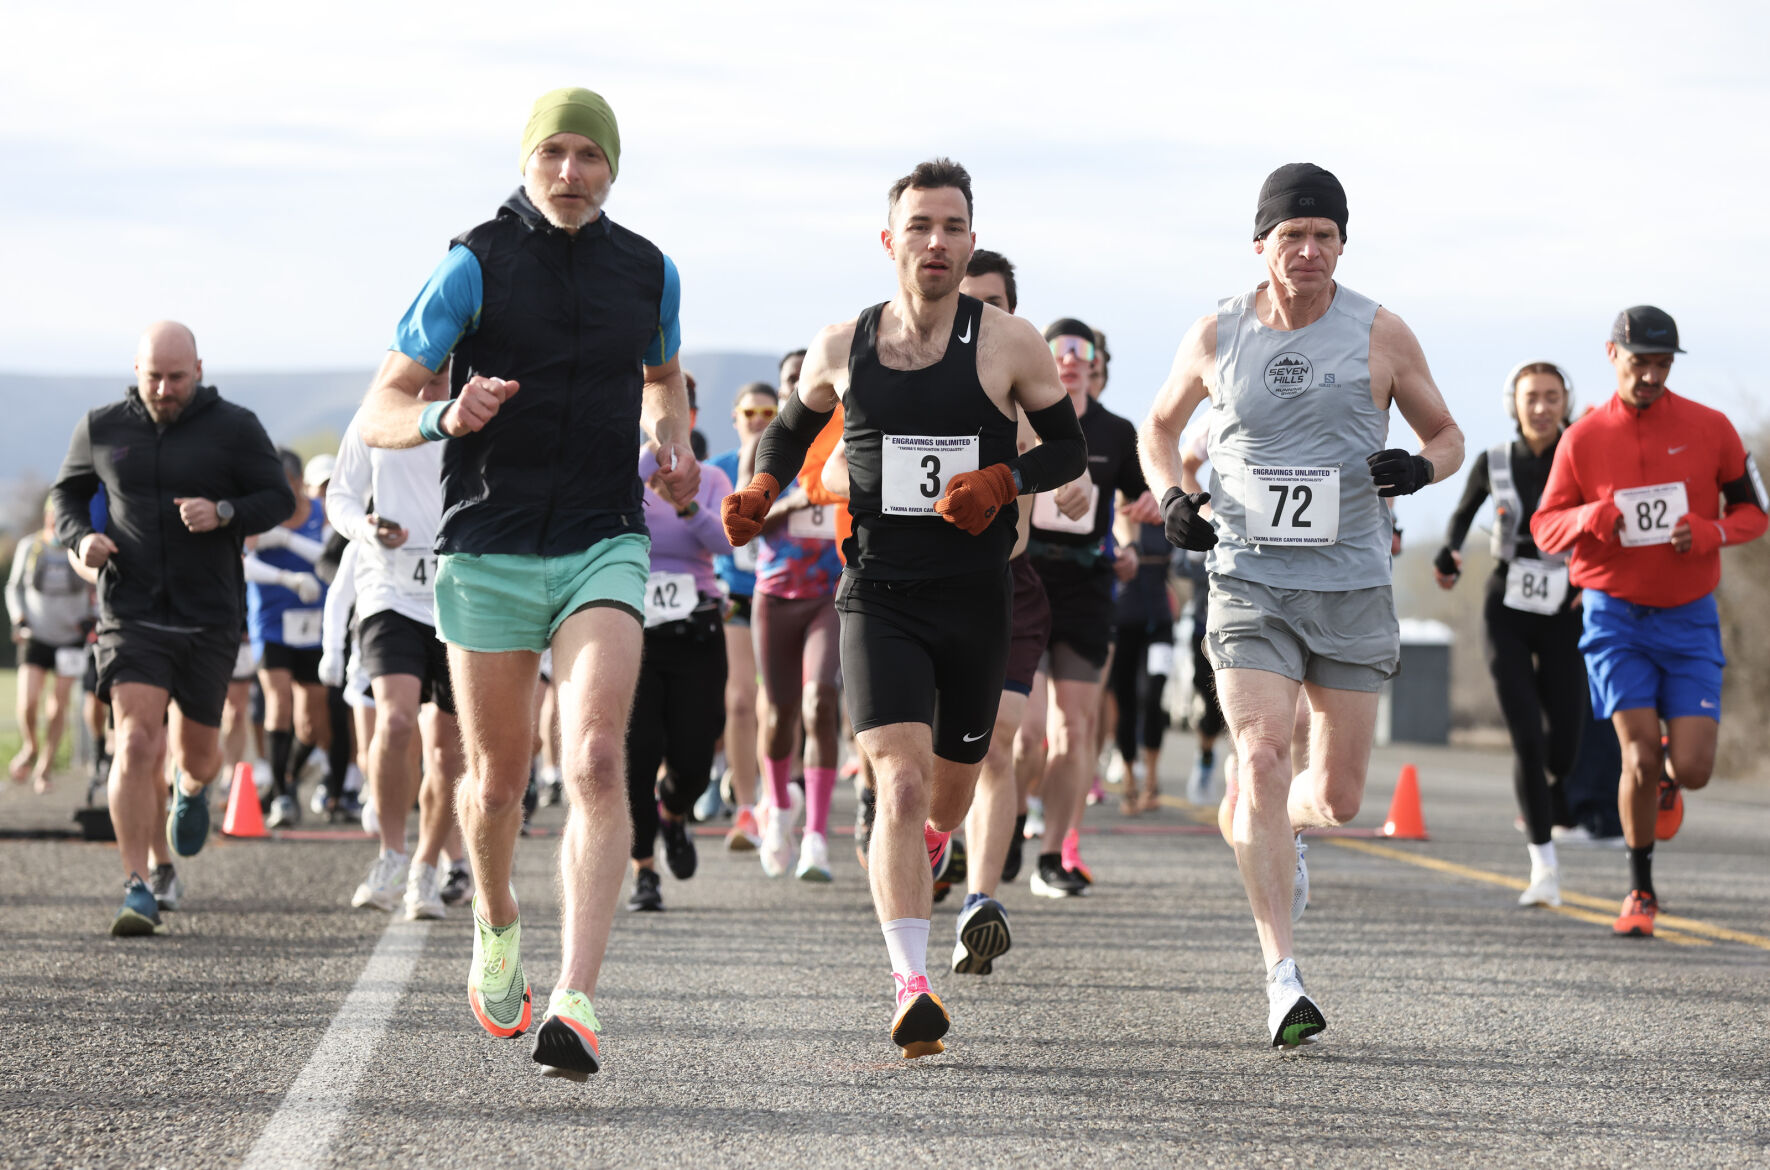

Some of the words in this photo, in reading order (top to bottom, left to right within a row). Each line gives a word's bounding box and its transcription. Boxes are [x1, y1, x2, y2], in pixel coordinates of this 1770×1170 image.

[1299, 197, 1315, 206] OR
[1269, 367, 1309, 376] SEVEN
[1273, 375, 1304, 384] HILLS
[892, 437, 934, 446] ENGRAVINGS
[935, 438, 971, 446] UNLIMITED
[920, 454, 941, 498] 3
[1252, 468, 1293, 476] ENGRAVINGS
[1295, 469, 1330, 477] UNLIMITED
[1268, 485, 1313, 528] 72
[1636, 499, 1669, 532] 82
[1521, 572, 1549, 599] 84
[653, 581, 681, 609] 42
